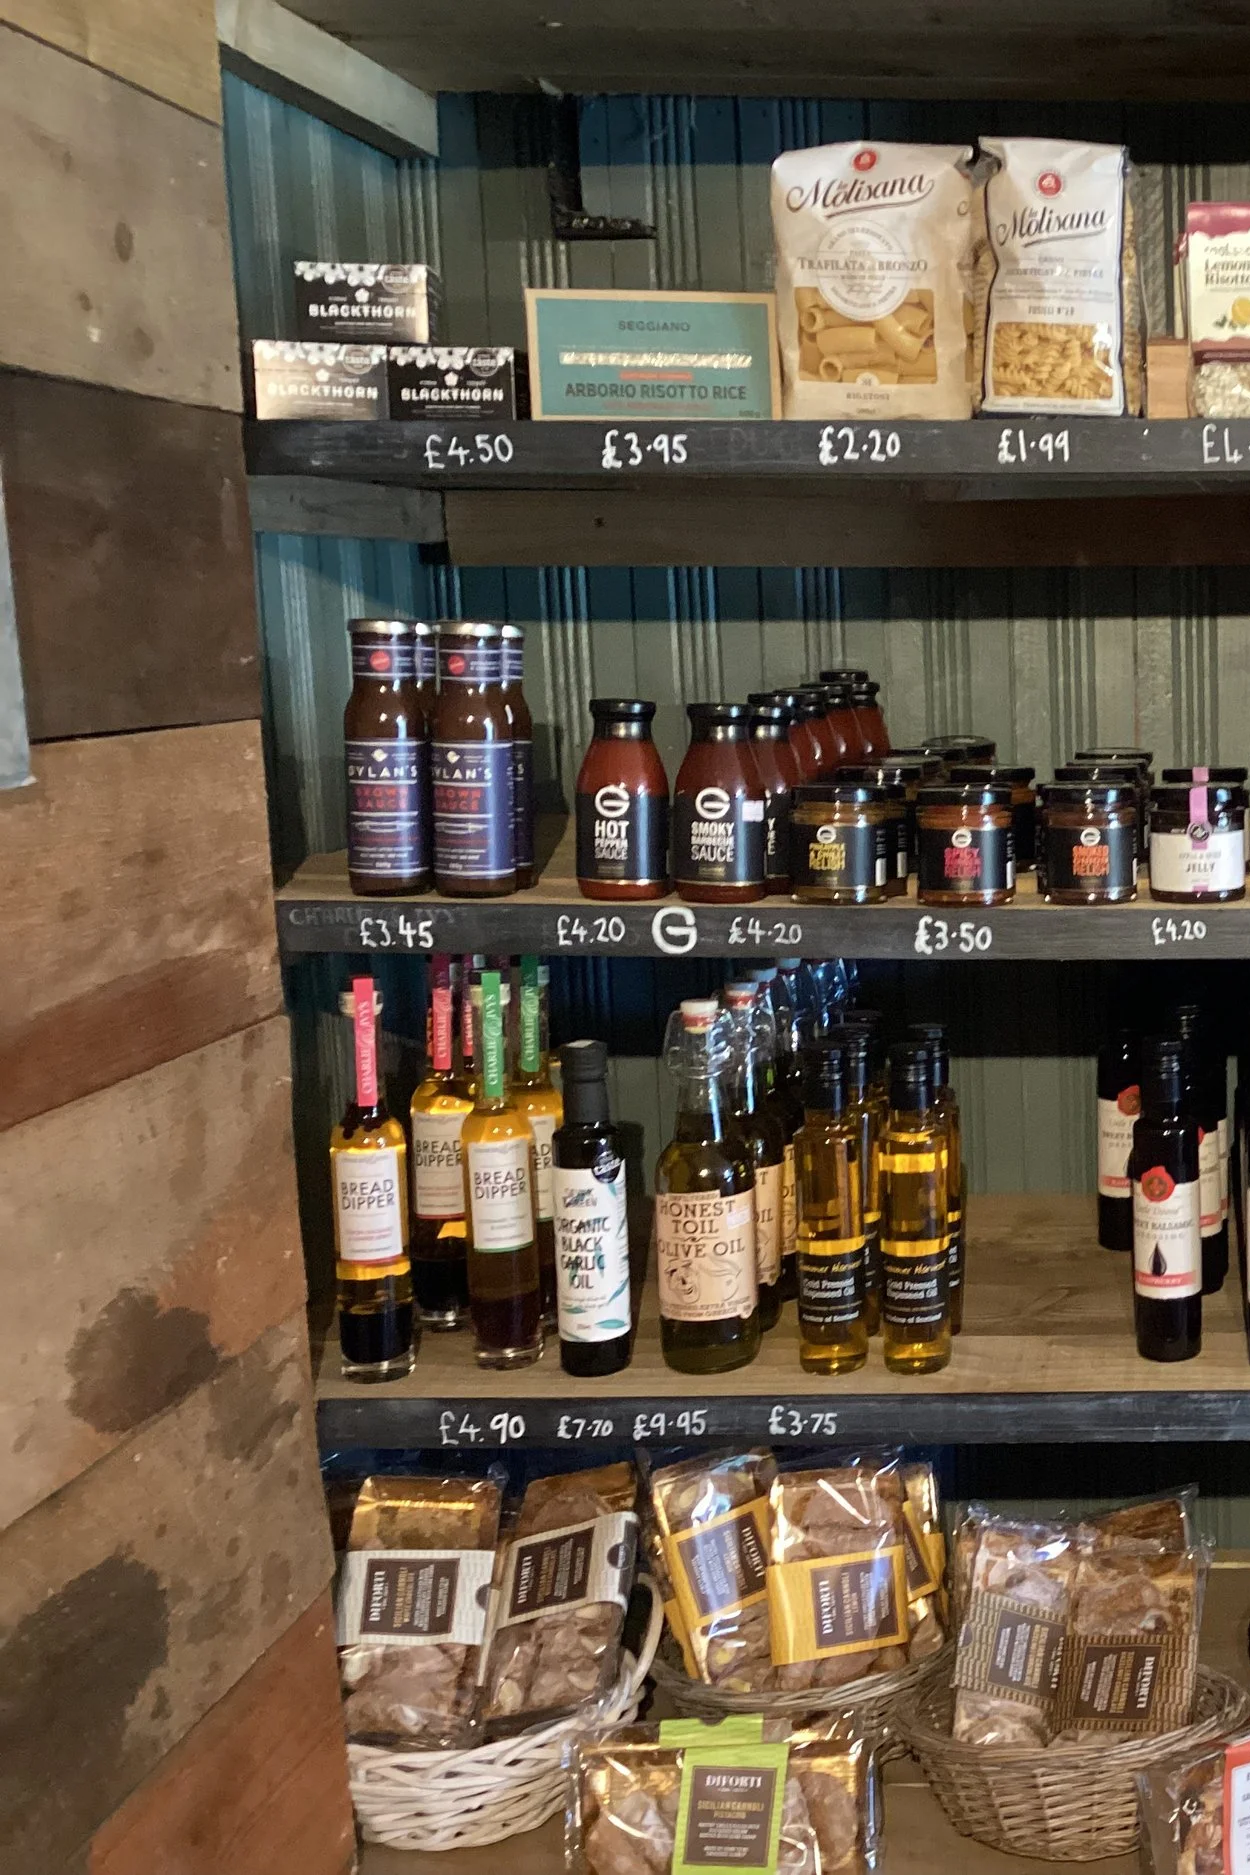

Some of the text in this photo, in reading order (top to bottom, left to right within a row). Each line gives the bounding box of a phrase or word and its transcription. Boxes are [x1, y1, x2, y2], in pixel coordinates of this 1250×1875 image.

[787, 173, 935, 218] Molisana
[998, 207, 1113, 247] Molisana
[1205, 258, 1250, 271] Lemon
[308, 304, 417, 320] BLACKTHORN
[618, 320, 691, 332] SEGGIANO
[268, 382, 379, 401] BLACKTHORN
[401, 386, 504, 403] BLACKTHORN
[565, 383, 747, 400] ARBORIO RISOTTO RICE
[424, 434, 514, 469] £4.50
[602, 431, 688, 468] £3.95
[818, 426, 901, 466] £2.20
[998, 428, 1070, 462] £1.99
[695, 787, 730, 820] G
[595, 821, 630, 838] HOT
[691, 822, 734, 837] SMOKY
[594, 847, 628, 861] SAUCE
[691, 845, 734, 862] SAUCE
[809, 859, 845, 870] RELISH
[1185, 862, 1216, 873] JELLY
[360, 915, 434, 948] £3.45
[557, 916, 625, 946] £4.20
[652, 906, 697, 955] G
[728, 917, 802, 946] £4.20
[914, 915, 993, 954] £3.50
[1152, 918, 1207, 945] £4.20
[437, 1016, 448, 1058] CHARLIE
[525, 1018, 535, 1061] CHARLIE
[360, 1048, 374, 1094] CHARLIE
[488, 1041, 499, 1085] CHARLIE
[415, 1139, 462, 1155] BREAD
[415, 1153, 463, 1167] DIPPER
[340, 1179, 394, 1195] BREAD
[474, 1168, 526, 1185] BREAD
[475, 1182, 526, 1199] DIPPER
[341, 1194, 395, 1210] DIPPER
[659, 1200, 736, 1218] HONEST
[556, 1216, 611, 1233] ORGANIC
[672, 1219, 719, 1234] TOIL
[561, 1237, 604, 1253] BLACK
[658, 1239, 745, 1258] OLIVE OIL
[561, 1255, 606, 1270] GARLIC
[571, 1274, 594, 1289] OIL
[439, 1411, 526, 1445] £4.90
[557, 1415, 614, 1439] £7.70
[633, 1409, 708, 1441] £9.95
[769, 1406, 838, 1436] £3.75
[742, 1527, 765, 1578] DIFORTI
[517, 1555, 532, 1605] DIFORTI
[369, 1570, 386, 1622] DIFORTI
[819, 1580, 834, 1635] DIFORTI
[1136, 1656, 1156, 1709] DIFORTI
[705, 1774, 763, 1787] DIFORTI
